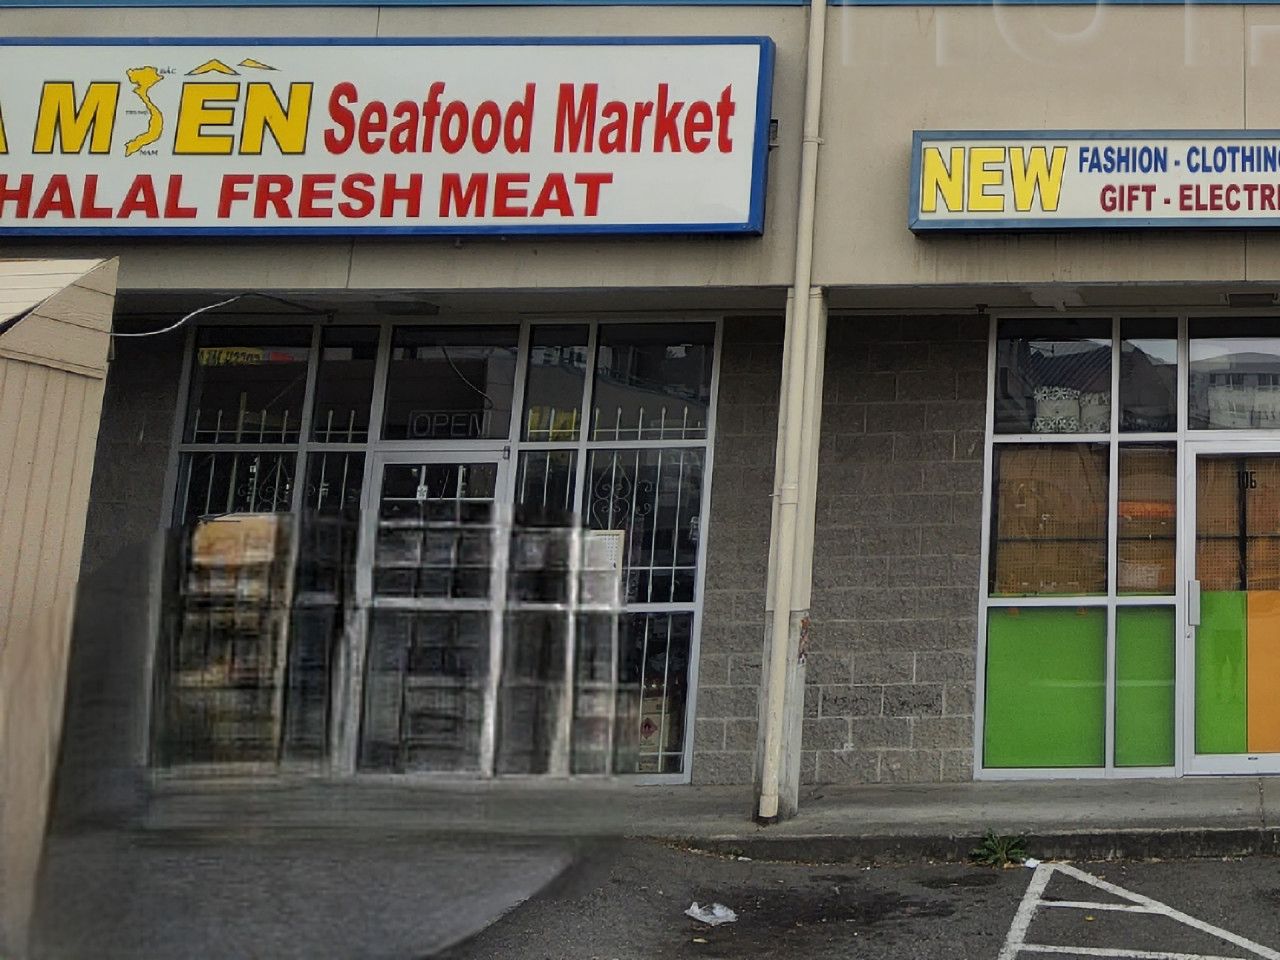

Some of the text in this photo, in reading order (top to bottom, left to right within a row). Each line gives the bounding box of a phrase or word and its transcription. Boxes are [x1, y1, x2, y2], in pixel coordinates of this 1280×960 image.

[323, 81, 534, 155] Seafood
[555, 82, 736, 154] Market
[1079, 146, 1168, 173] FASHION
[0, 172, 614, 219] HALAL FRESH MEAT
[921, 146, 1068, 213] NEW
[1100, 184, 1157, 212] GIFT
[413, 413, 486, 437] OPEN
